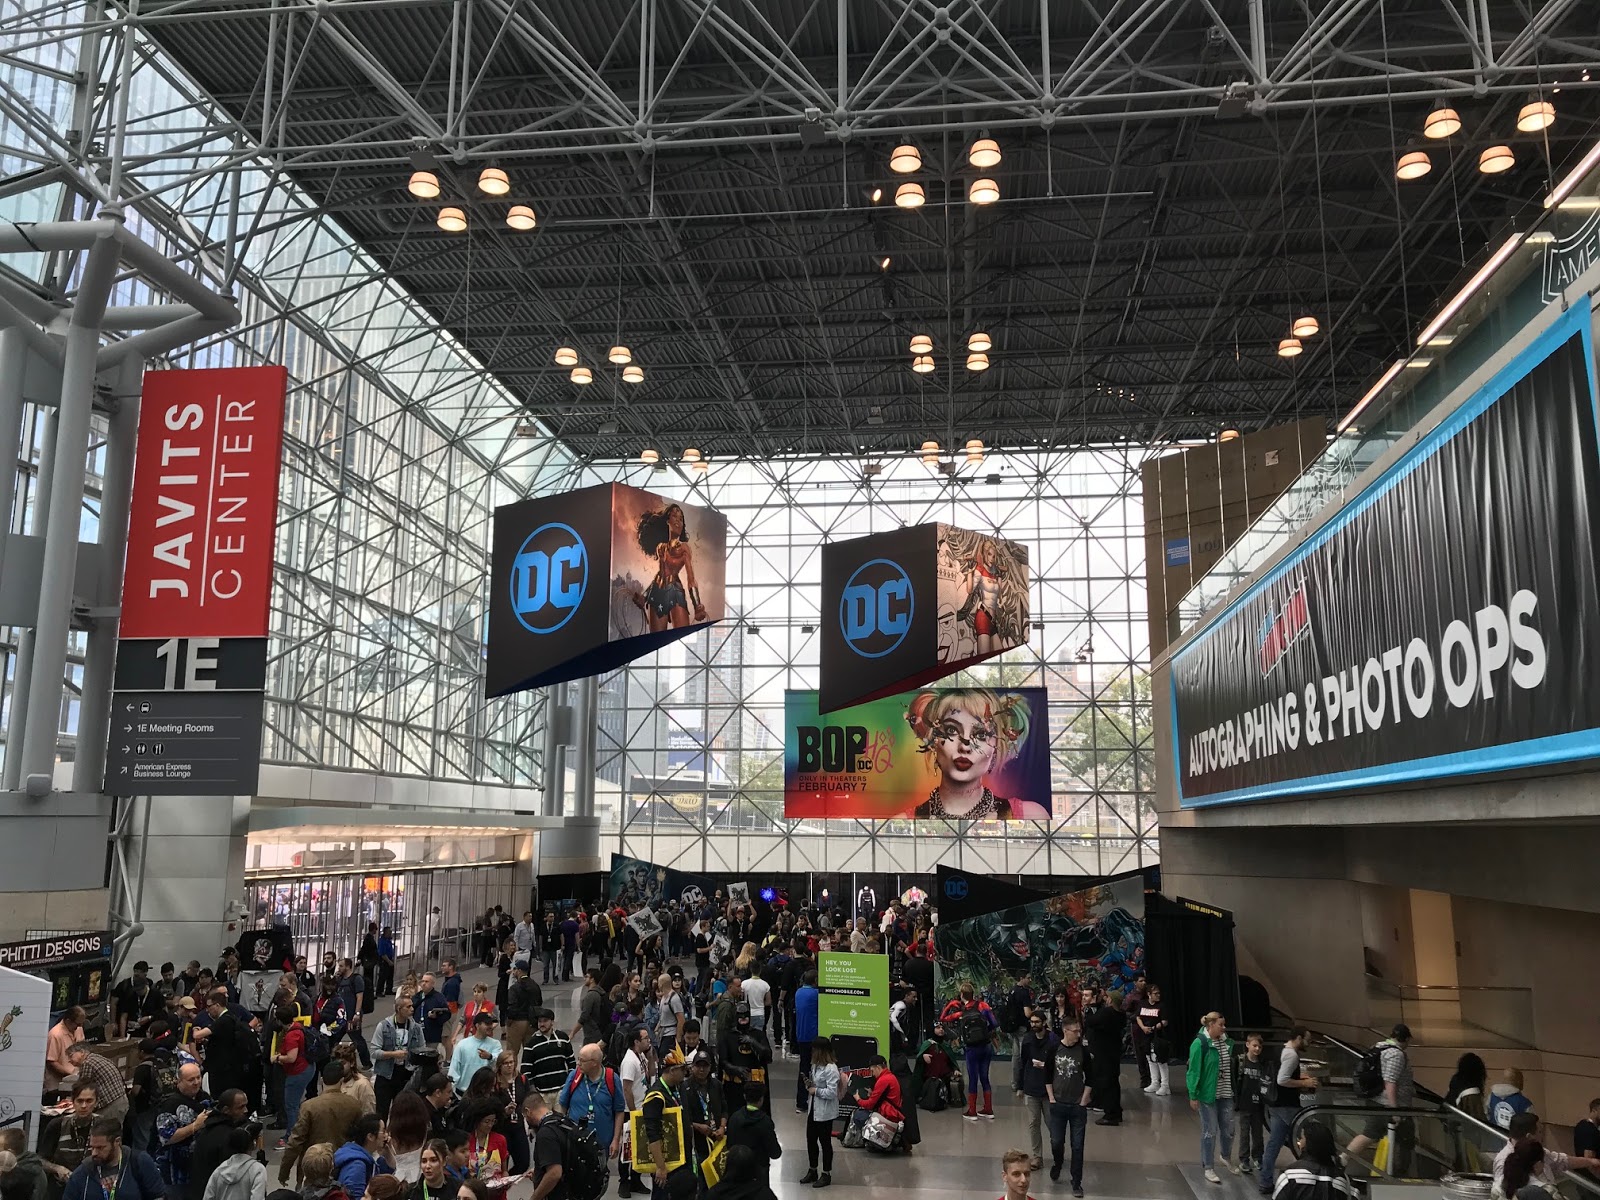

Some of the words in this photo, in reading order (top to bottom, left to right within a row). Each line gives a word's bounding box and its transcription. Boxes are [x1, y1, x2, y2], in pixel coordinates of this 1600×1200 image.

[1557, 229, 1600, 286] AME
[149, 403, 204, 599] JAVITS
[211, 399, 256, 600] CENTER
[511, 541, 586, 616] DC
[841, 574, 913, 643] DC
[156, 638, 220, 690] 1E
[1189, 692, 1301, 778] AUTOGRAPHING
[1305, 682, 1323, 746] &
[1322, 637, 1435, 742] PHOTO
[1441, 589, 1546, 708] OPS
[137, 724, 147, 732] 1E
[149, 723, 183, 734] Meeting
[184, 723, 215, 732] Rooms
[796, 726, 867, 773] BOP
[133, 770, 164, 778] Business
[166, 770, 191, 779] Lounge
[134, 763, 165, 771] American
[166, 763, 191, 772] Express
[857, 758, 873, 772] DC
[798, 782, 858, 791] FEBRUARY
[861, 782, 867, 791] 7
[681, 886, 703, 904] DC
[944, 878, 968, 898] DC
[0, 944, 40, 963] PHITTI
[45, 936, 101, 957] DESIGNS
[1140, 1007, 1160, 1017] MARVEL
[1299, 1093, 1317, 1101] ONLY
